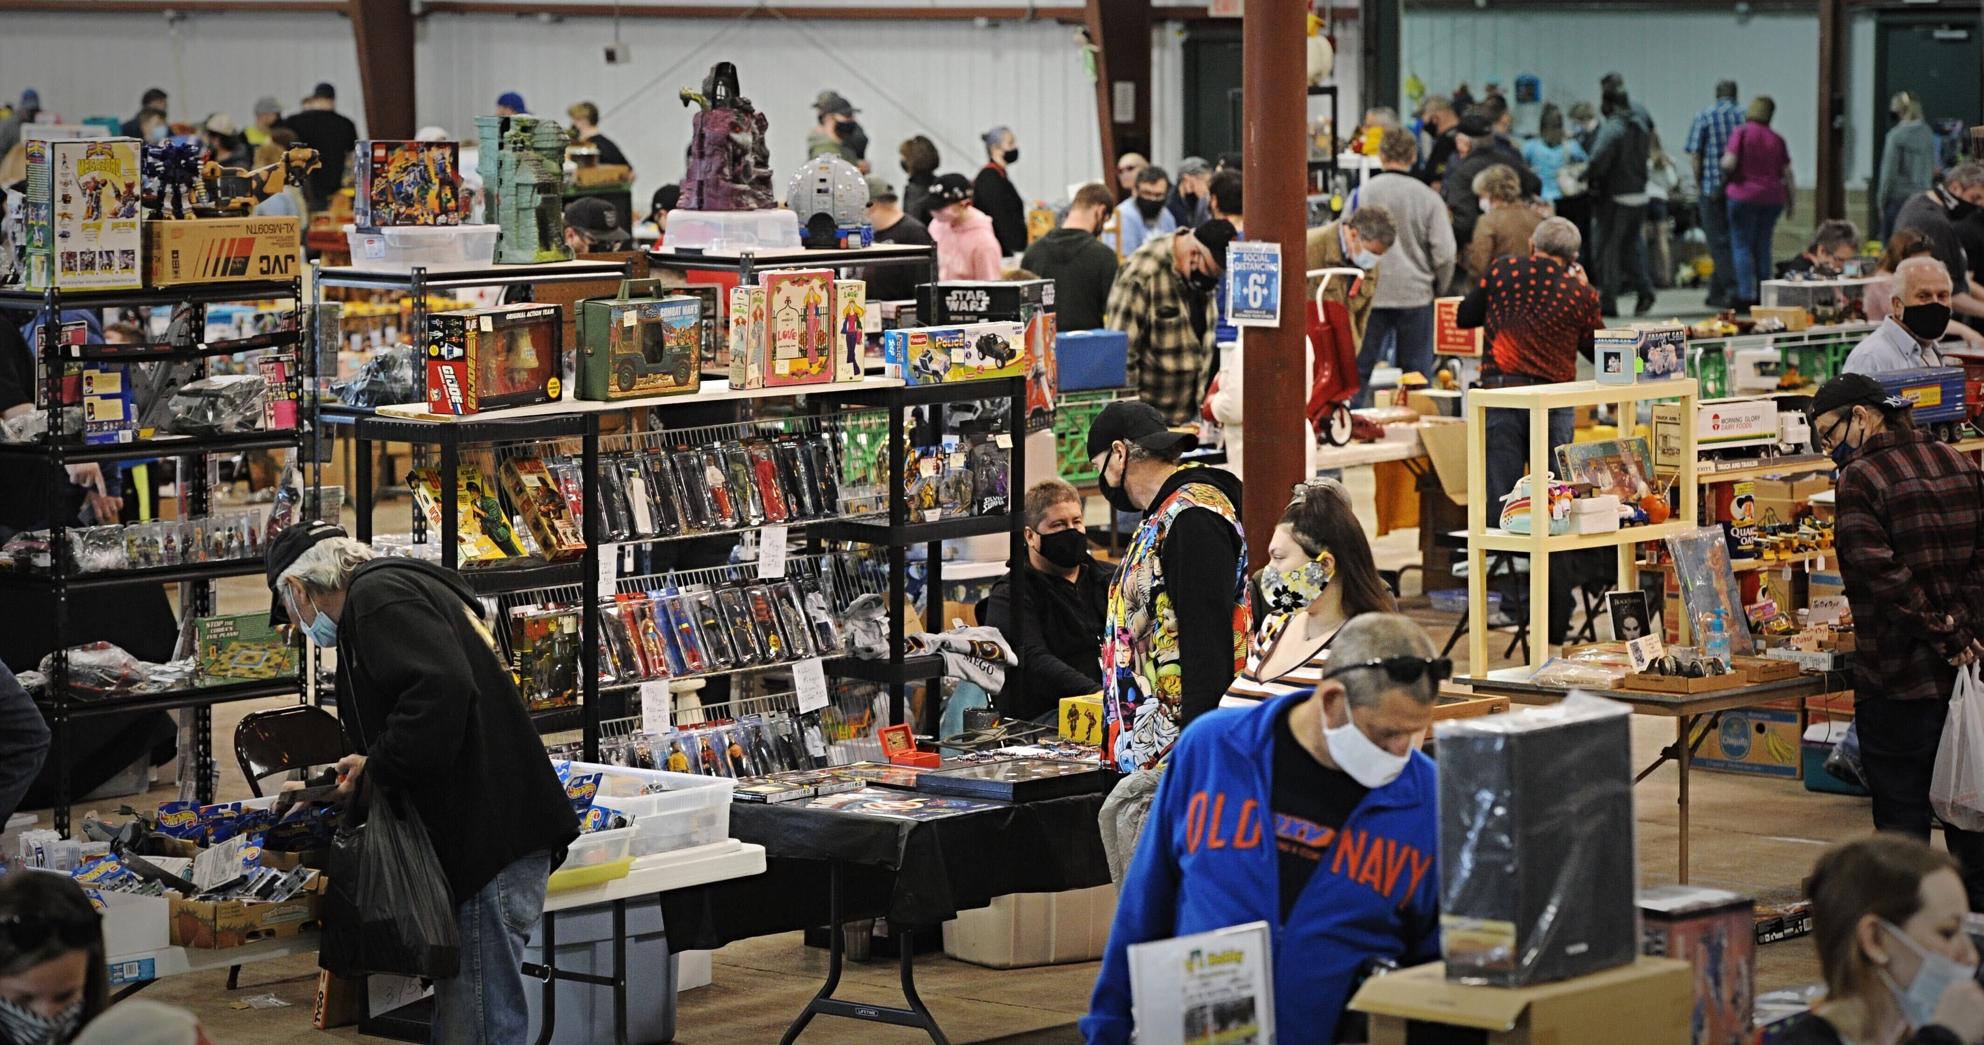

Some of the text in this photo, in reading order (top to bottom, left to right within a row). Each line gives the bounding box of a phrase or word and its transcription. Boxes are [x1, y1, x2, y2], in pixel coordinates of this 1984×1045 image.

[1243, 253, 1270, 262] SOCIAL
[259, 254, 296, 275] JVC
[1234, 262, 1278, 272] DISTANCING
[945, 290, 990, 300] STAR
[946, 300, 989, 311] WARS
[505, 308, 555, 320] ORIGINAL ACTION TEAM
[660, 306, 681, 317] COMBAT
[935, 335, 965, 349] POLICE
[1721, 415, 1761, 424] MORNING GLORY
[1721, 423, 1735, 431] DAIRY
[1717, 463, 1731, 471] TRUCK
[206, 621, 224, 629] STOP
[962, 654, 995, 676] MEGO
[1187, 791, 1262, 856] OLD
[1331, 829, 1433, 909] NAVY
[314, 990, 324, 1023] TYCO
